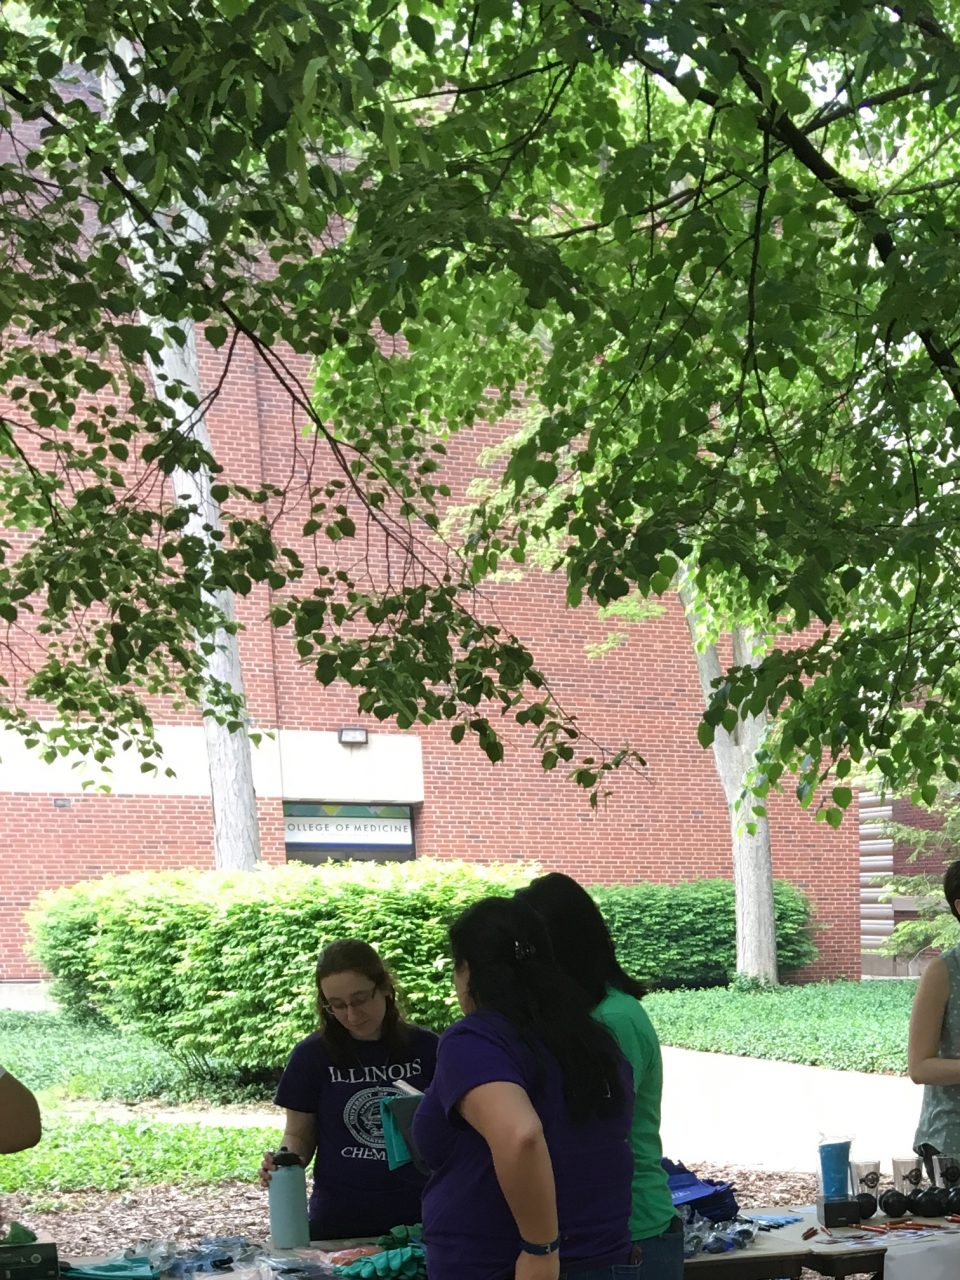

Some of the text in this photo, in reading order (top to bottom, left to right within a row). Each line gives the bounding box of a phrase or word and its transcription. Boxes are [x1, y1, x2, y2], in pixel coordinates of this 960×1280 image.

[287, 823, 409, 833] OLLEGE OF MEDICINE
[328, 1059, 422, 1083] ILLINOIS
[341, 1146, 386, 1161] CHEM
